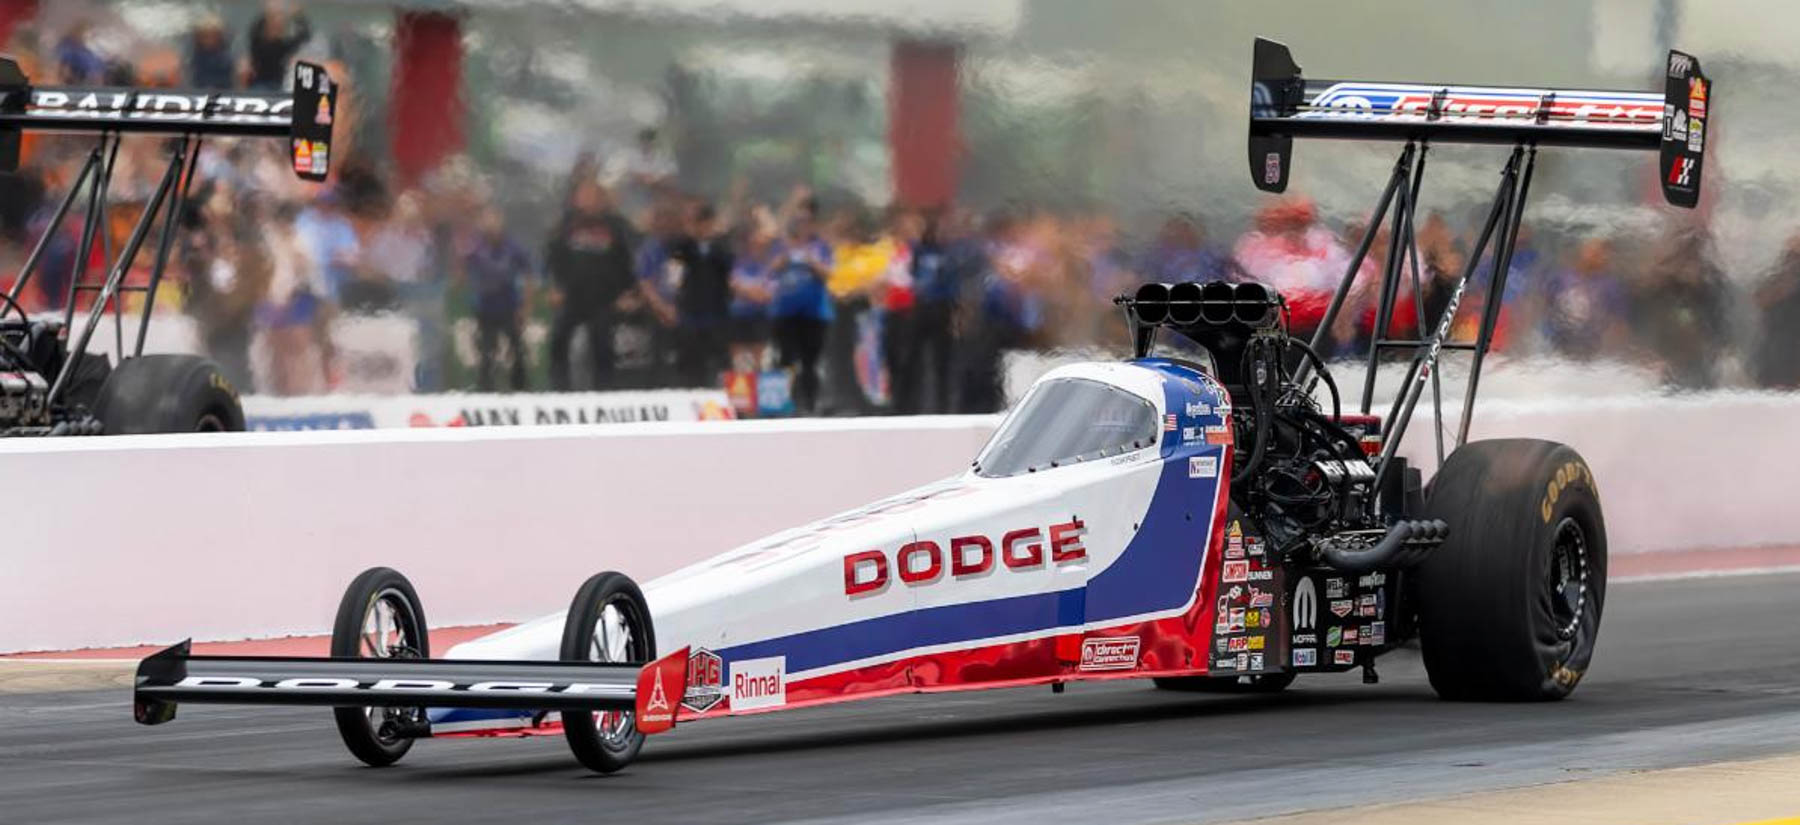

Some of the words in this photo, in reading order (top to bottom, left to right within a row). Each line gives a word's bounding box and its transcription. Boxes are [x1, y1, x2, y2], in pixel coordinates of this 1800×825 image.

[844, 519, 1088, 598] DODGE
[174, 676, 638, 694] DODGE
[735, 668, 780, 699] Rinnai
